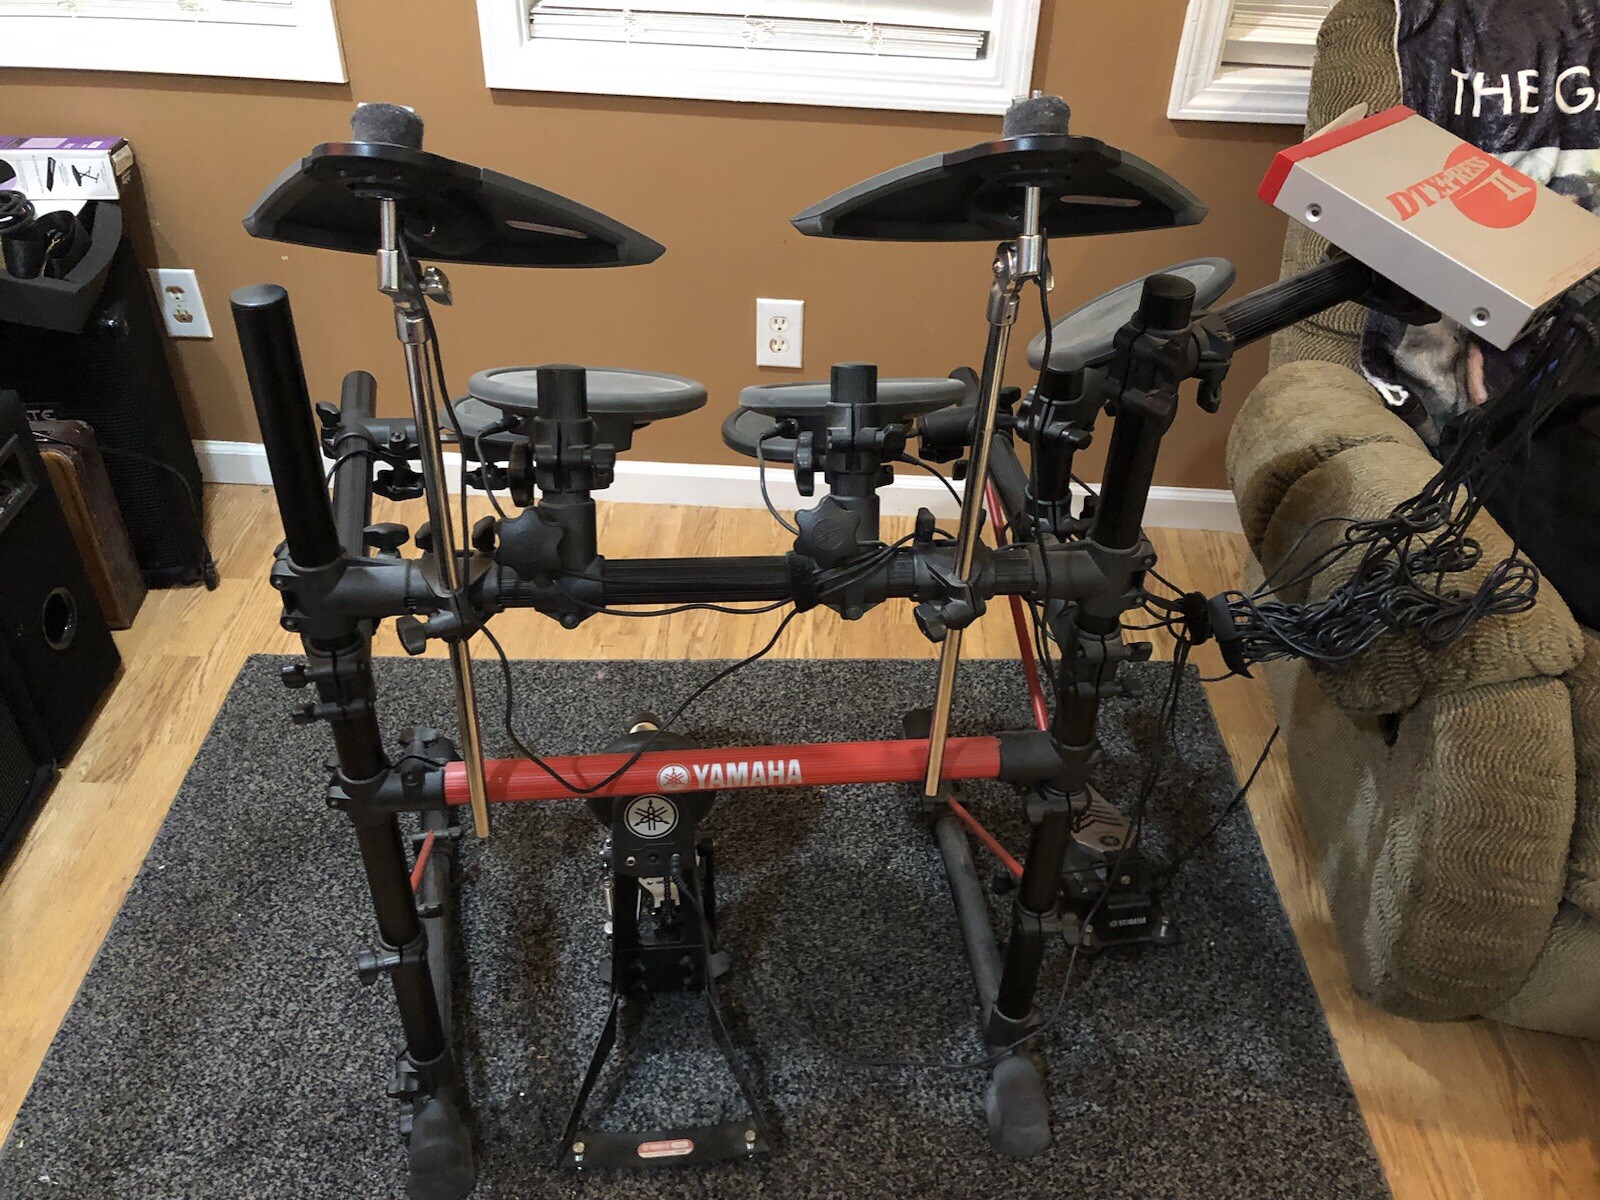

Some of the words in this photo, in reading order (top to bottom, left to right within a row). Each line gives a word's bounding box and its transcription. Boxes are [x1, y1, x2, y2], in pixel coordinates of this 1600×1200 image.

[1451, 67, 1539, 117] THE
[1555, 65, 1600, 114] G
[692, 758, 802, 789] YAMAHA
